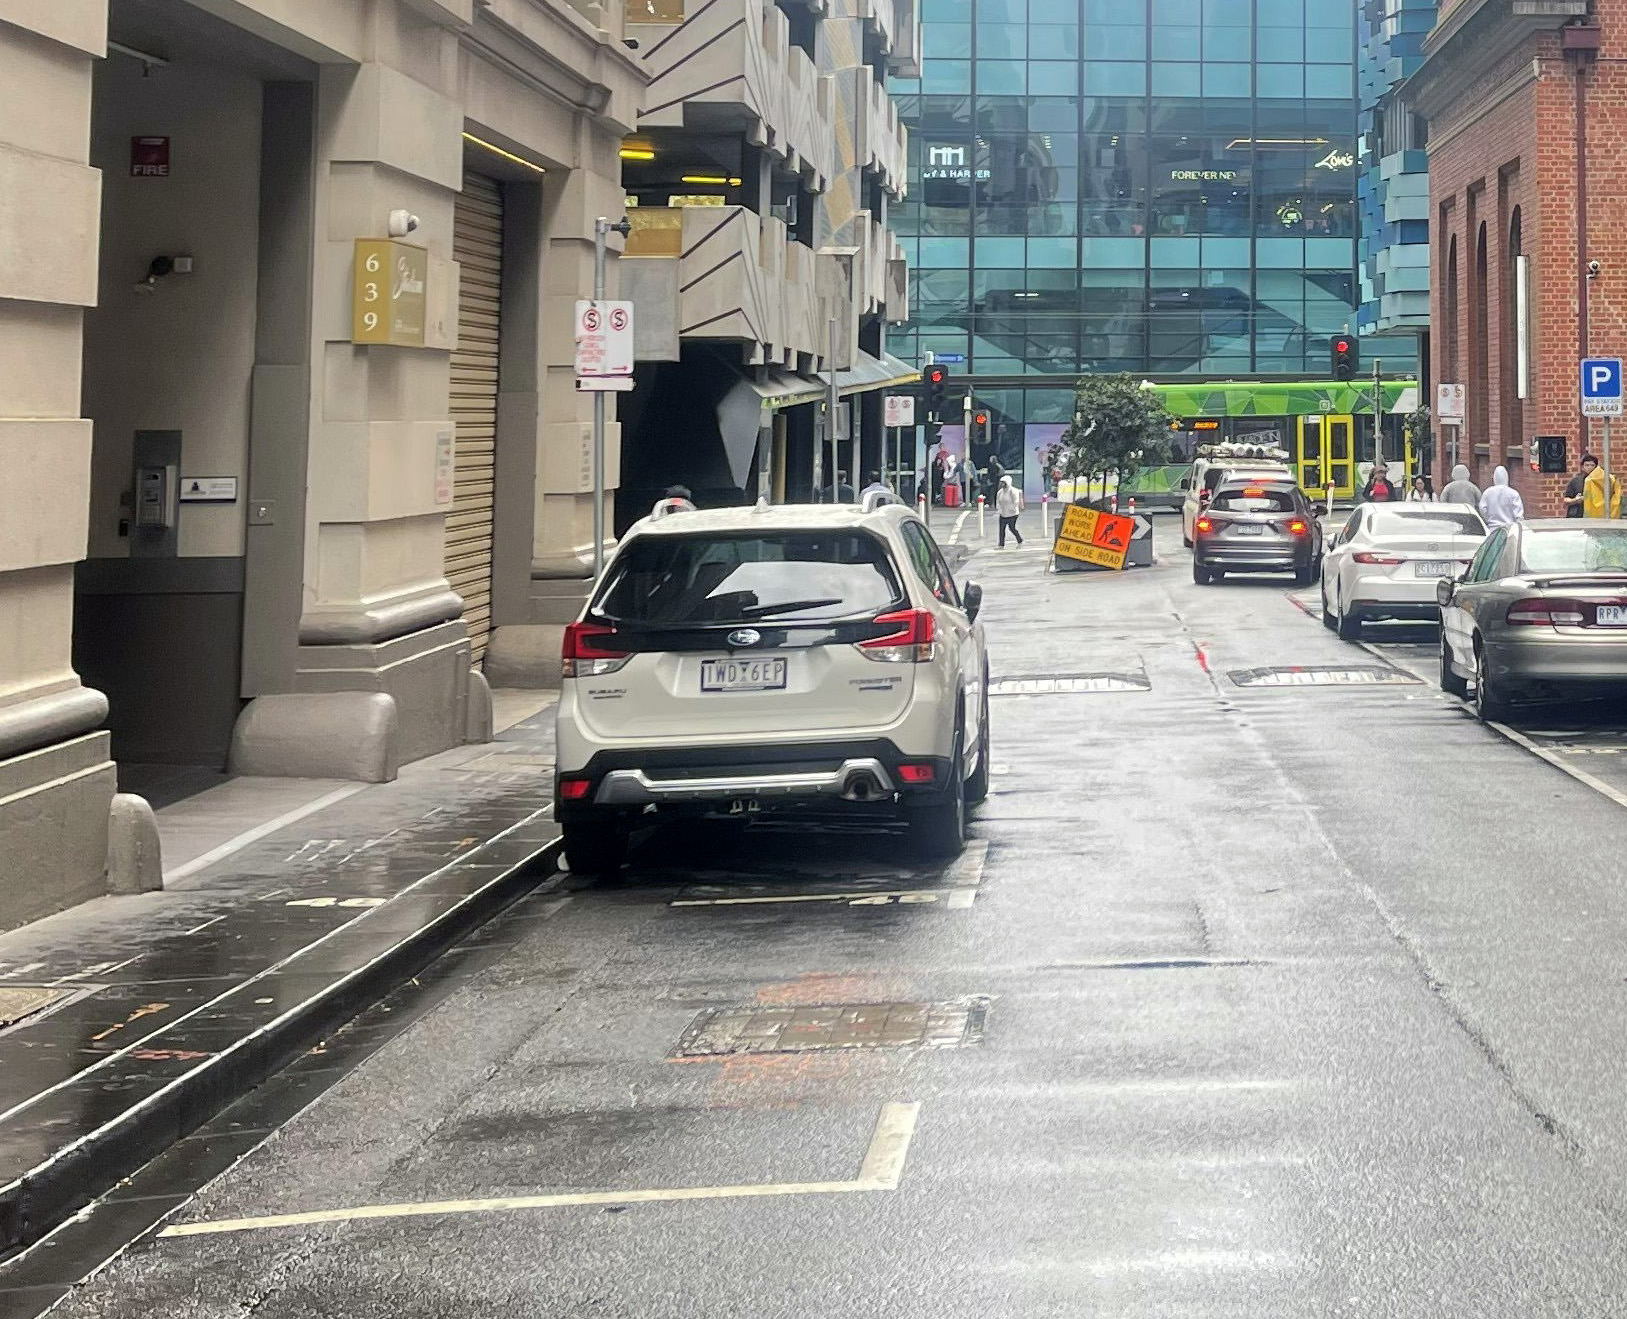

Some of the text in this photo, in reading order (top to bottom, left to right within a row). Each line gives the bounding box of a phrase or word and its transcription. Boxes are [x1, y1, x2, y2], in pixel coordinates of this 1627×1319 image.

[133, 165, 168, 175] FIRE
[940, 169, 948, 178] &
[949, 169, 991, 178] HARER
[1591, 366, 1612, 392] P
[1584, 404, 1605, 413] AREA
[1070, 508, 1095, 521] ROAD
[1068, 518, 1092, 530] WORK
[1062, 527, 1092, 541] AHEAD
[1058, 542, 1121, 565] ON SIDE ROAD
